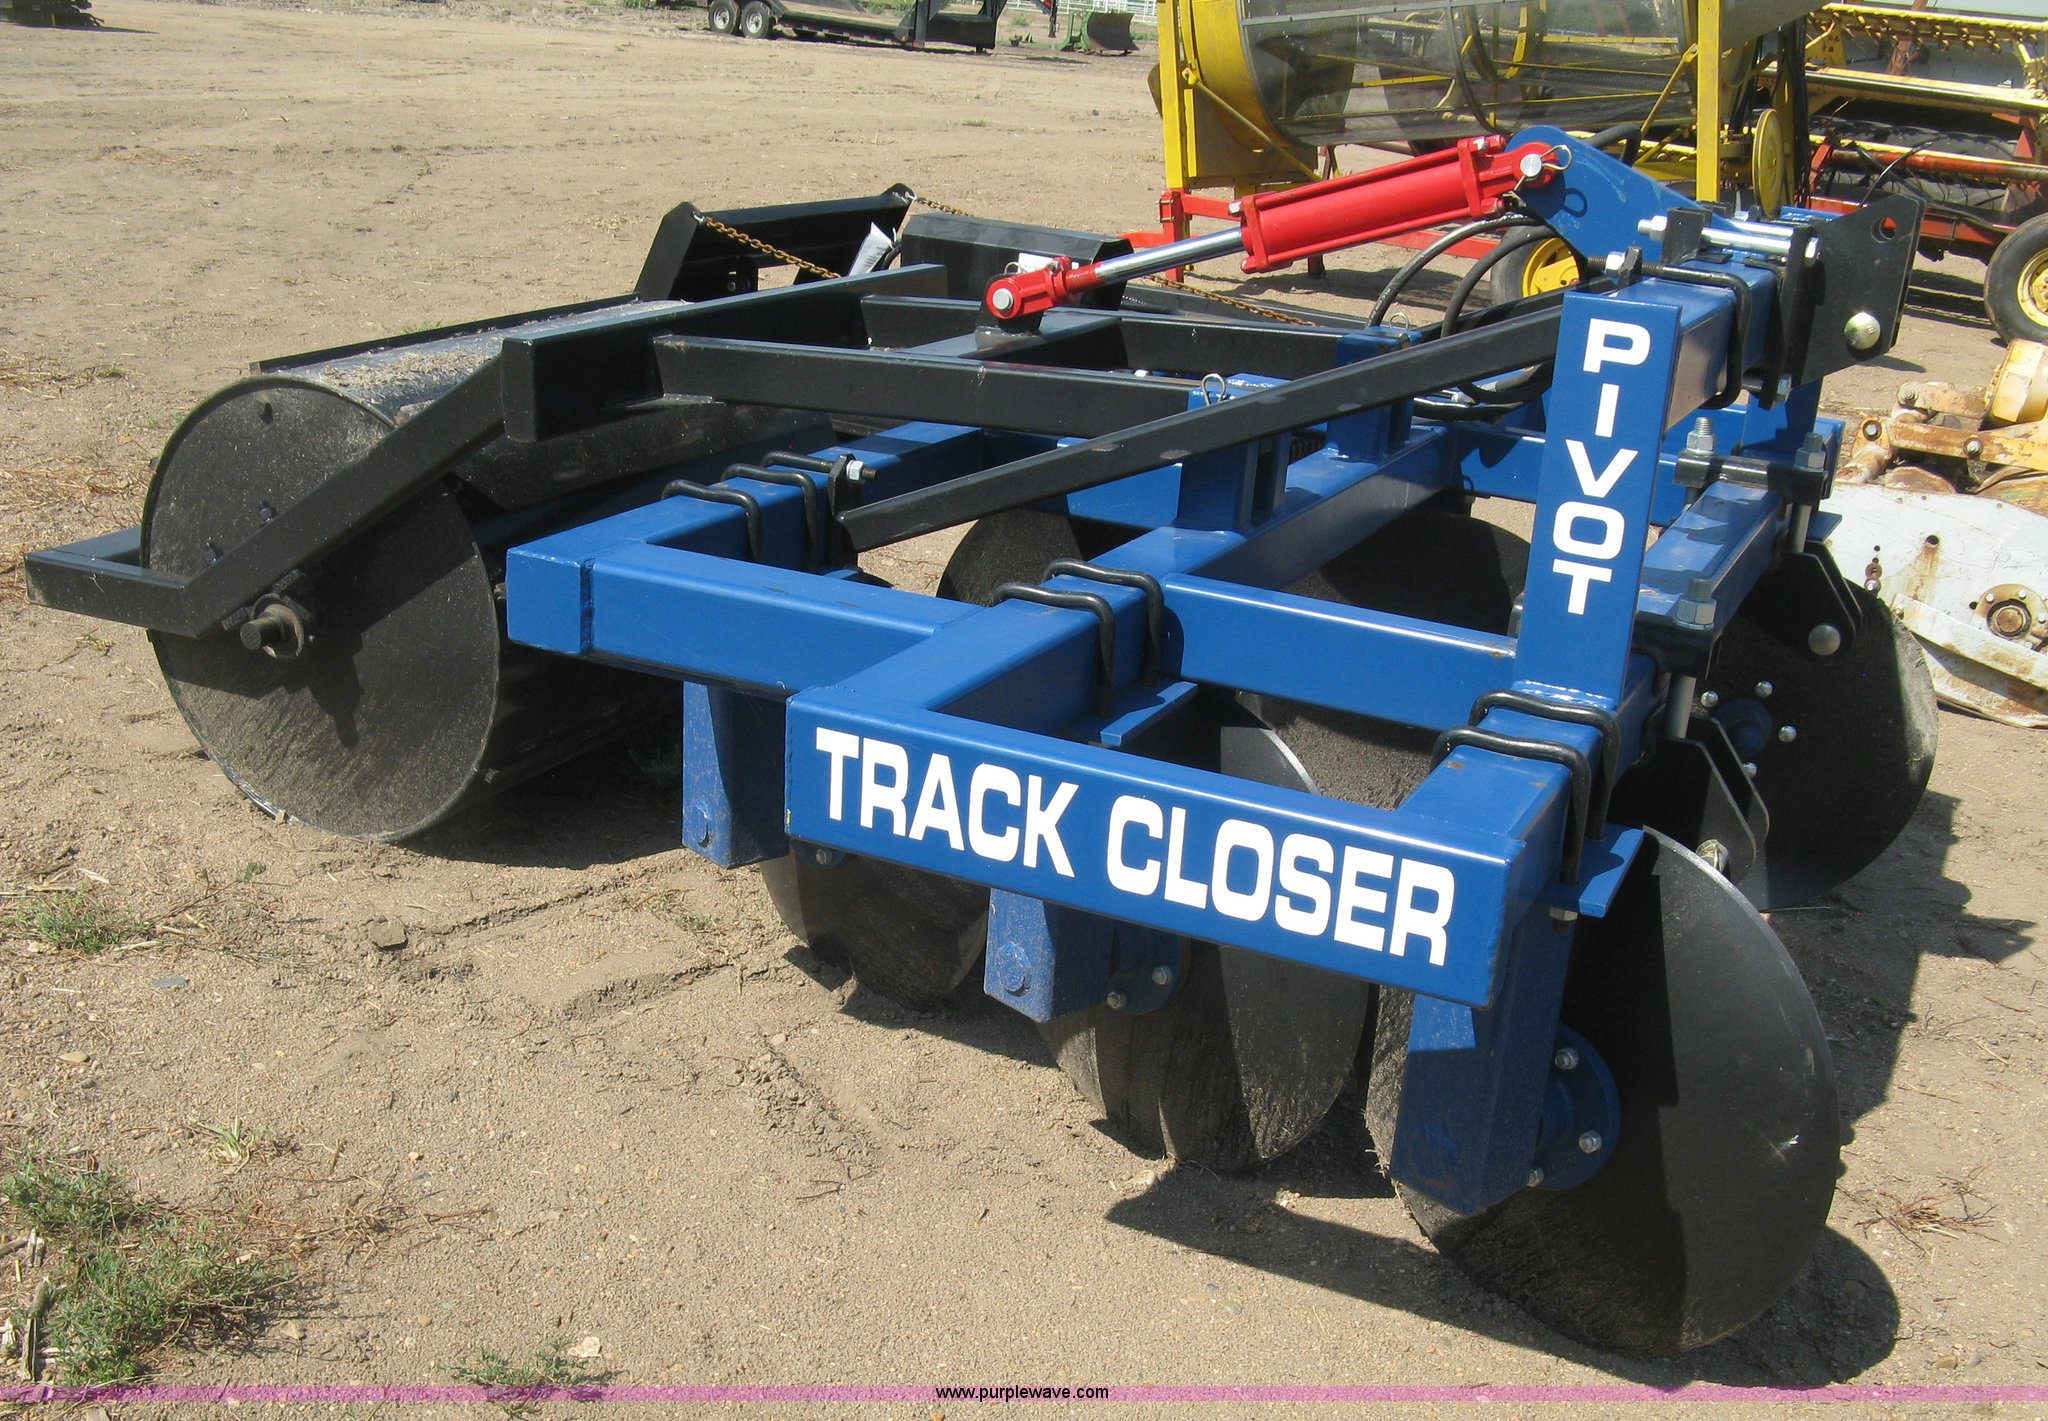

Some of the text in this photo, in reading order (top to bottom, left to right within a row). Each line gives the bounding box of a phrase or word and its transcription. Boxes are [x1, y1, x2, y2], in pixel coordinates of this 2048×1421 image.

[1552, 317, 1650, 616] PIVOT
[815, 726, 1455, 967] TRACK CLOSER
